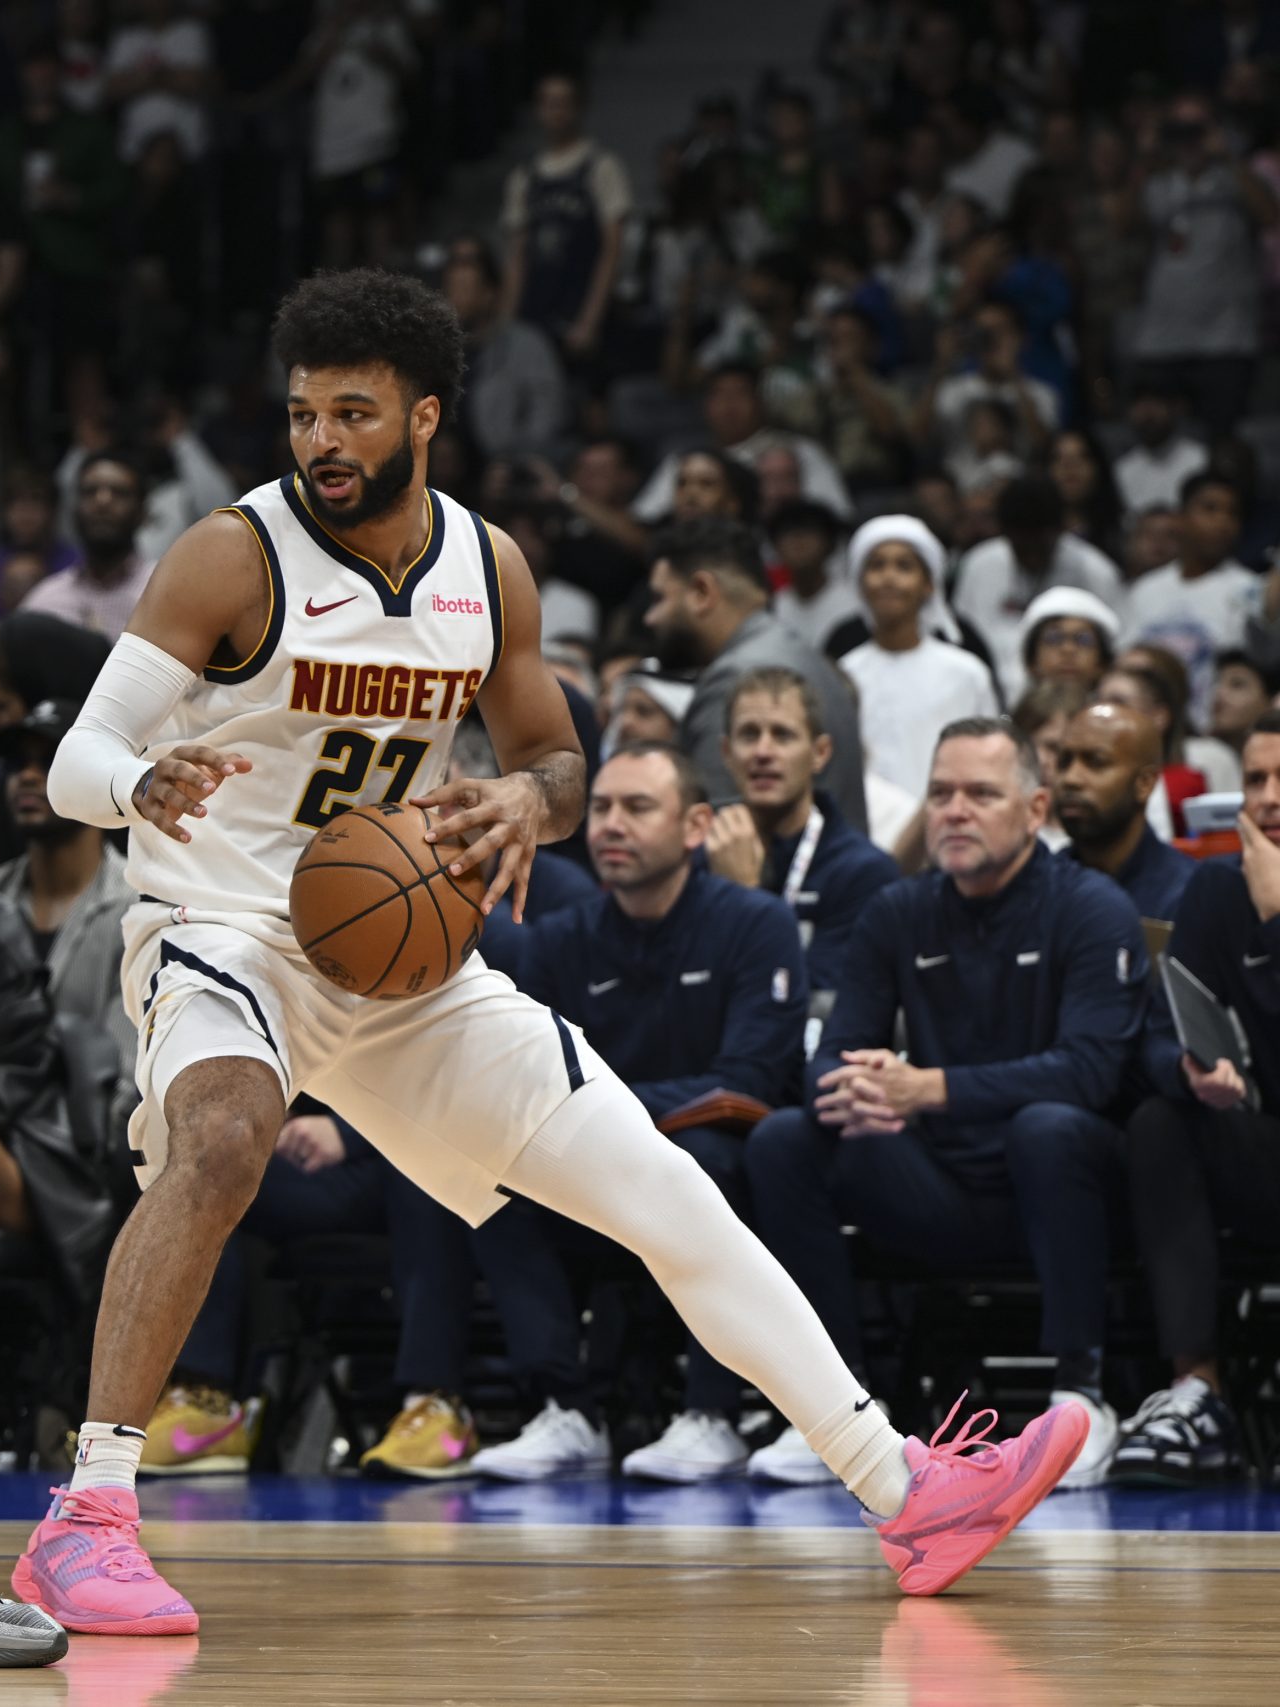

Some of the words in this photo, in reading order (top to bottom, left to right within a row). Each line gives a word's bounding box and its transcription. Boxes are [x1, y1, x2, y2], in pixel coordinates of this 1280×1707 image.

[432, 594, 483, 614] ibotta
[289, 658, 483, 721] NUGGETS
[292, 728, 431, 831] 27
